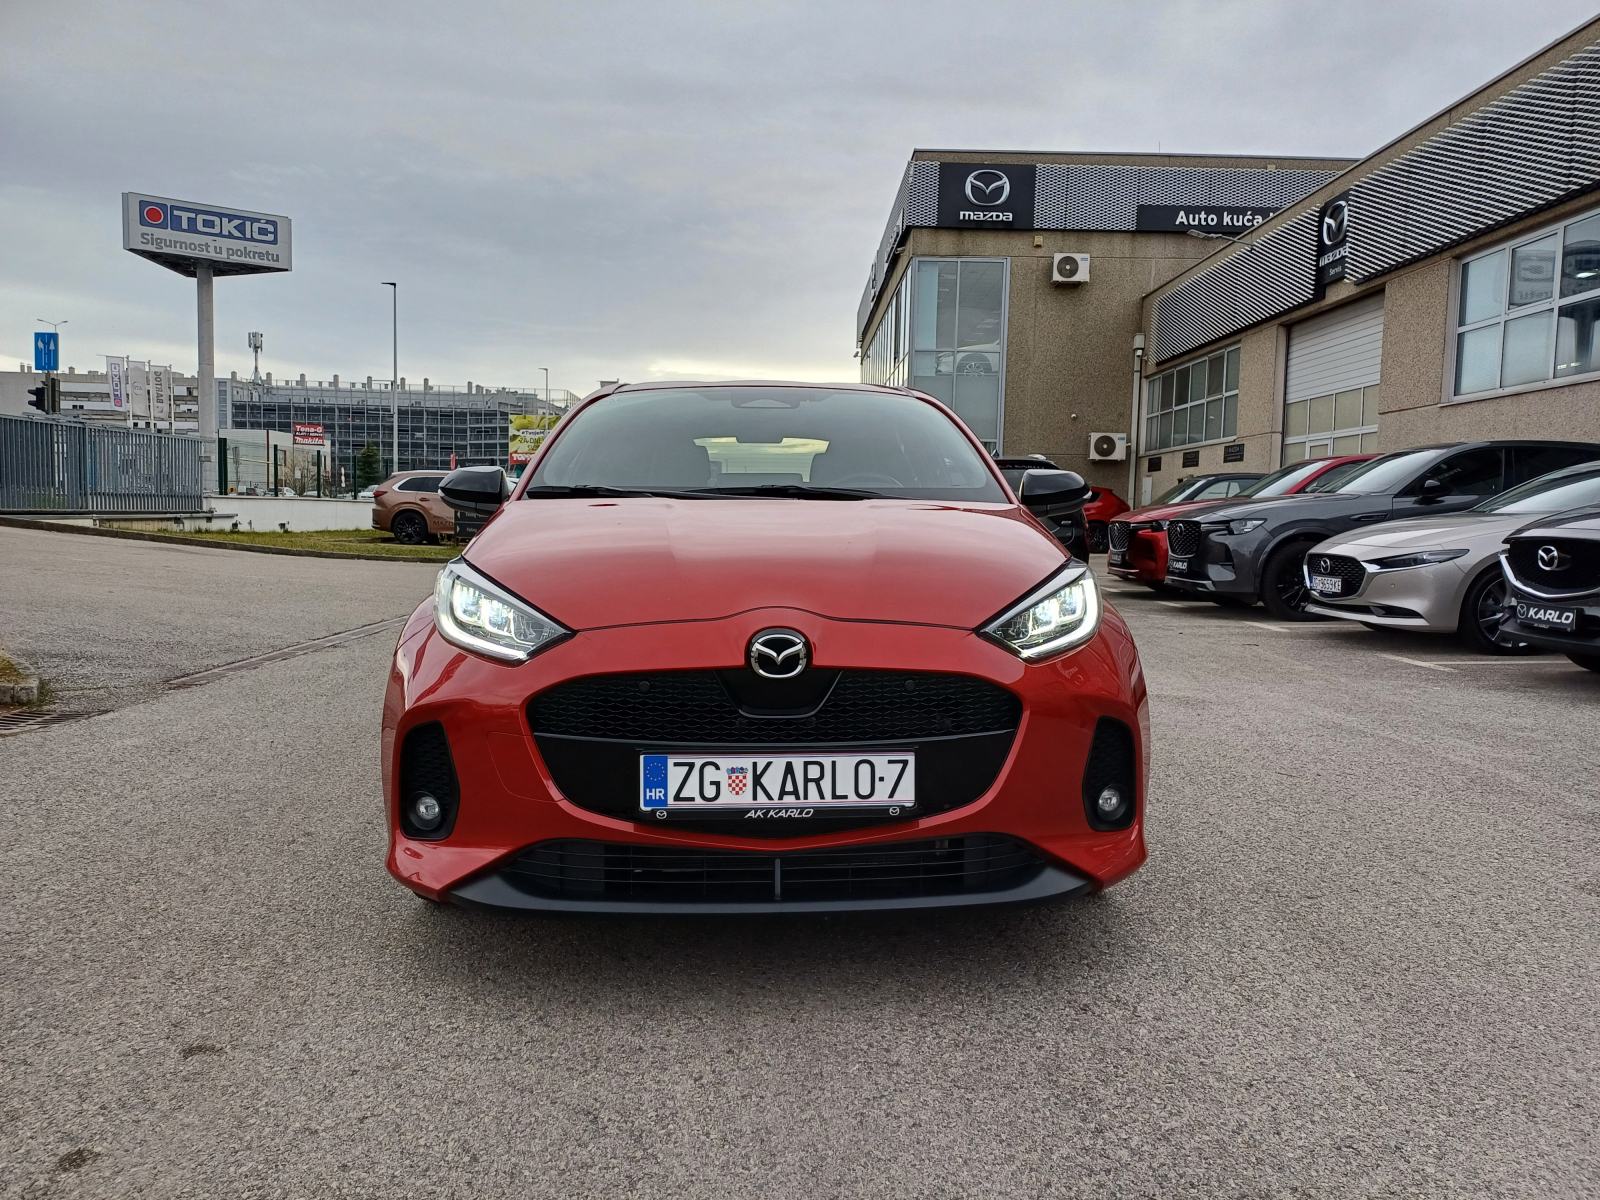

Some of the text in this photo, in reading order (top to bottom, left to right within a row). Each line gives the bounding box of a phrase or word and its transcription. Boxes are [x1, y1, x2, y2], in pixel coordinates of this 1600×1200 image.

[1175, 210, 1263, 226] Auto kuća
[140, 232, 280, 263] Sigurnost u pokretu
[1527, 606, 1574, 625] KARLO
[672, 761, 721, 803] ZG
[646, 788, 665, 801] HR
[744, 807, 815, 819] AK KARLO
